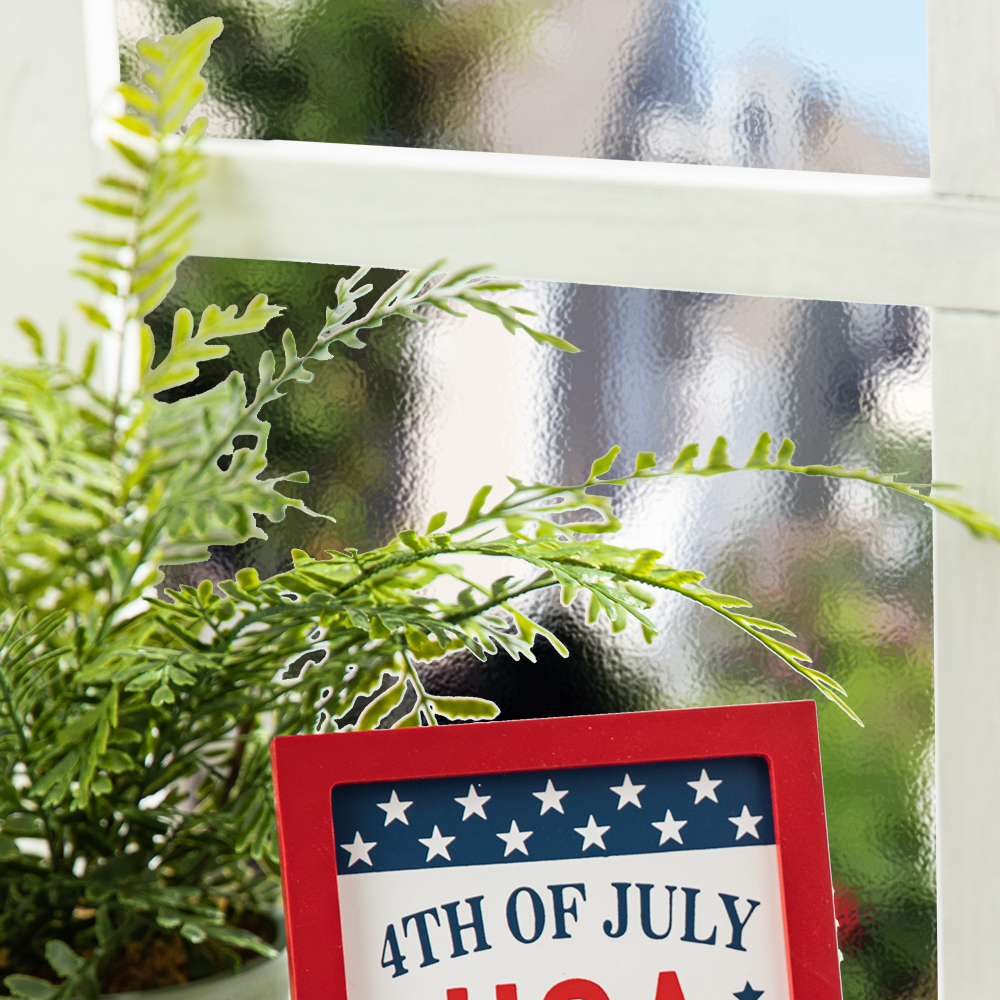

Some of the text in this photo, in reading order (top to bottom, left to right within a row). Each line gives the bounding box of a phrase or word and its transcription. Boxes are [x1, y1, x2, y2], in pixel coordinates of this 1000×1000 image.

[380, 882, 761, 979] 4TH OF JULY
